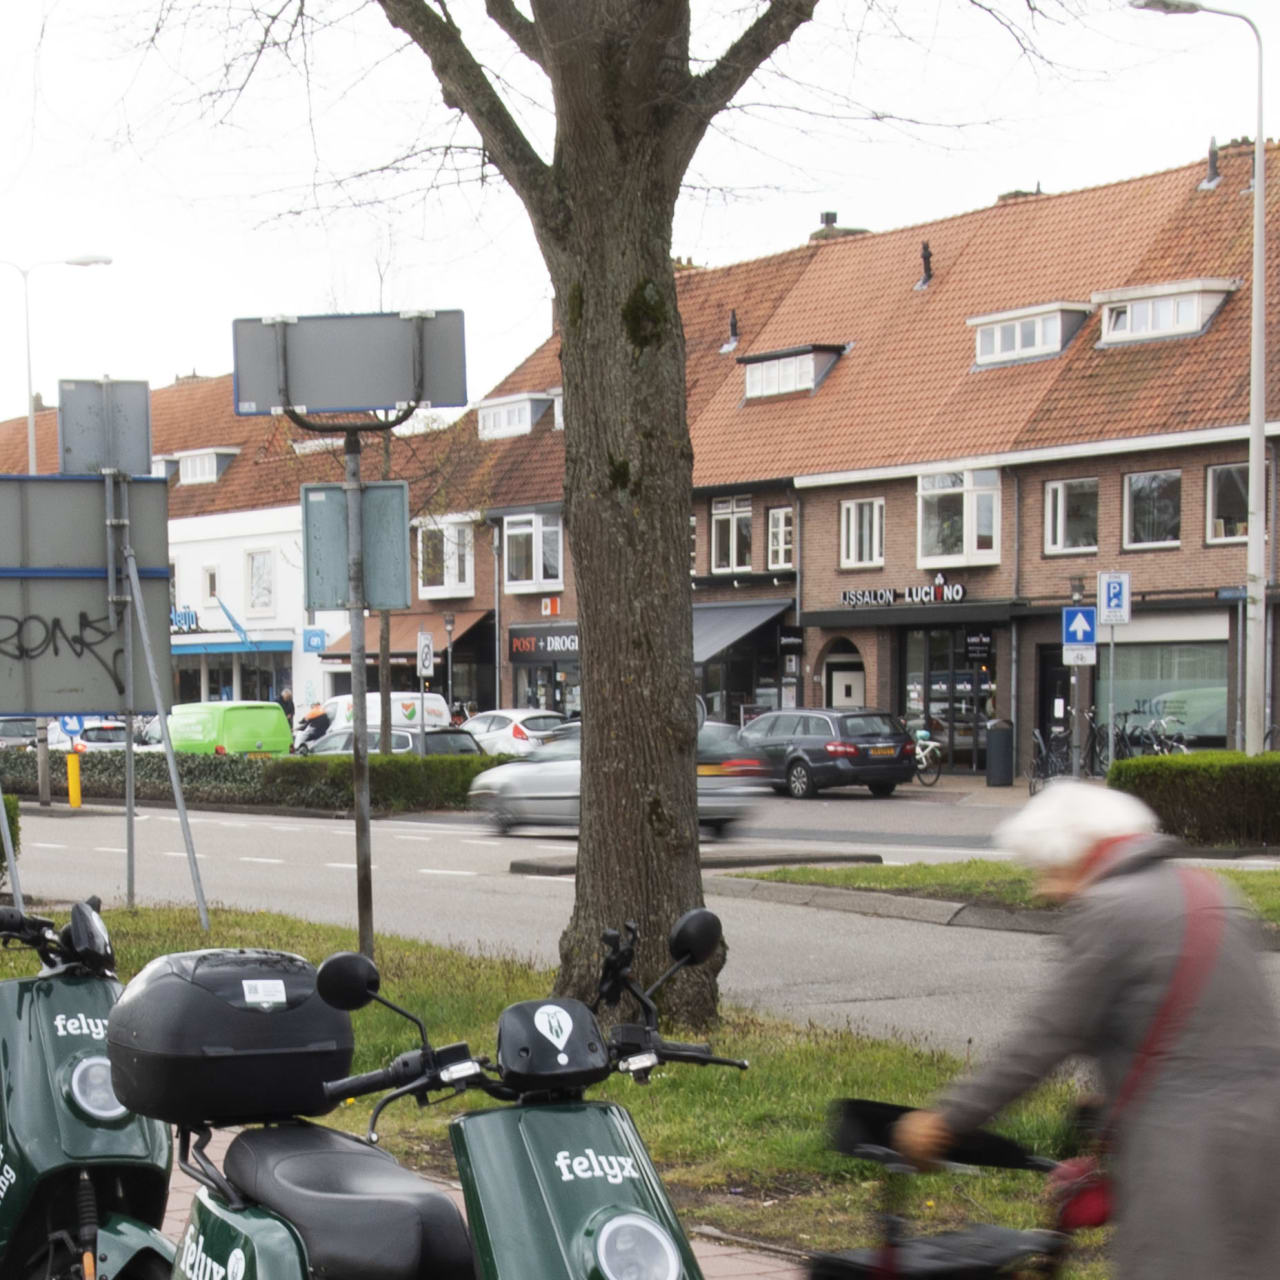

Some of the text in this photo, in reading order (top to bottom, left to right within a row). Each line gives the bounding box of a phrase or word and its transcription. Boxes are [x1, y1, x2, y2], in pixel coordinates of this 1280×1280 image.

[840, 588, 895, 605] IJSSALON
[512, 637, 537, 651] POST
[554, 1148, 640, 1185] felyx
